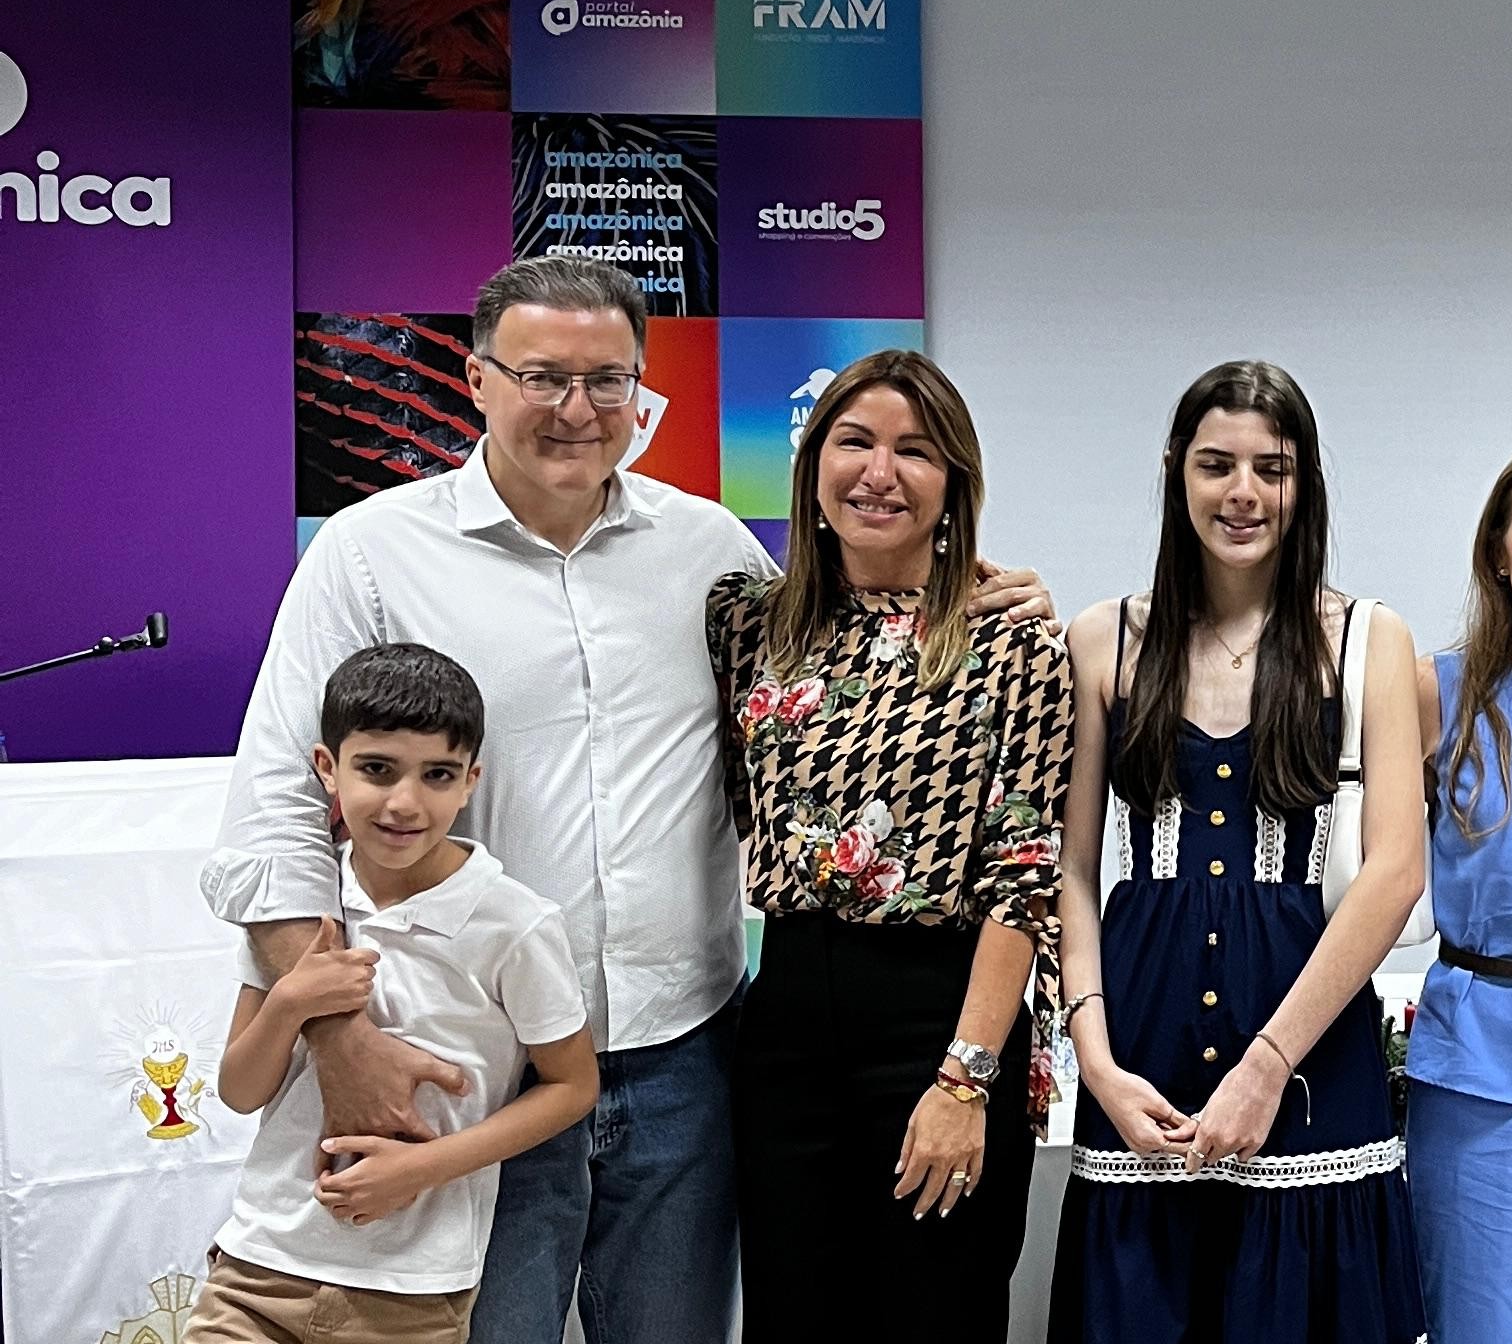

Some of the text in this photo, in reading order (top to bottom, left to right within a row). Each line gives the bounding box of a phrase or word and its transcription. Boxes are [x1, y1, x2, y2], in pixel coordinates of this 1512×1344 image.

[585, 1, 635, 14] portal
[582, 10, 683, 28] amazônia
[545, 147, 683, 168] amazônica
[545, 177, 683, 200] amazônica
[545, 208, 683, 231] amazônica
[758, 199, 886, 241] studio5
